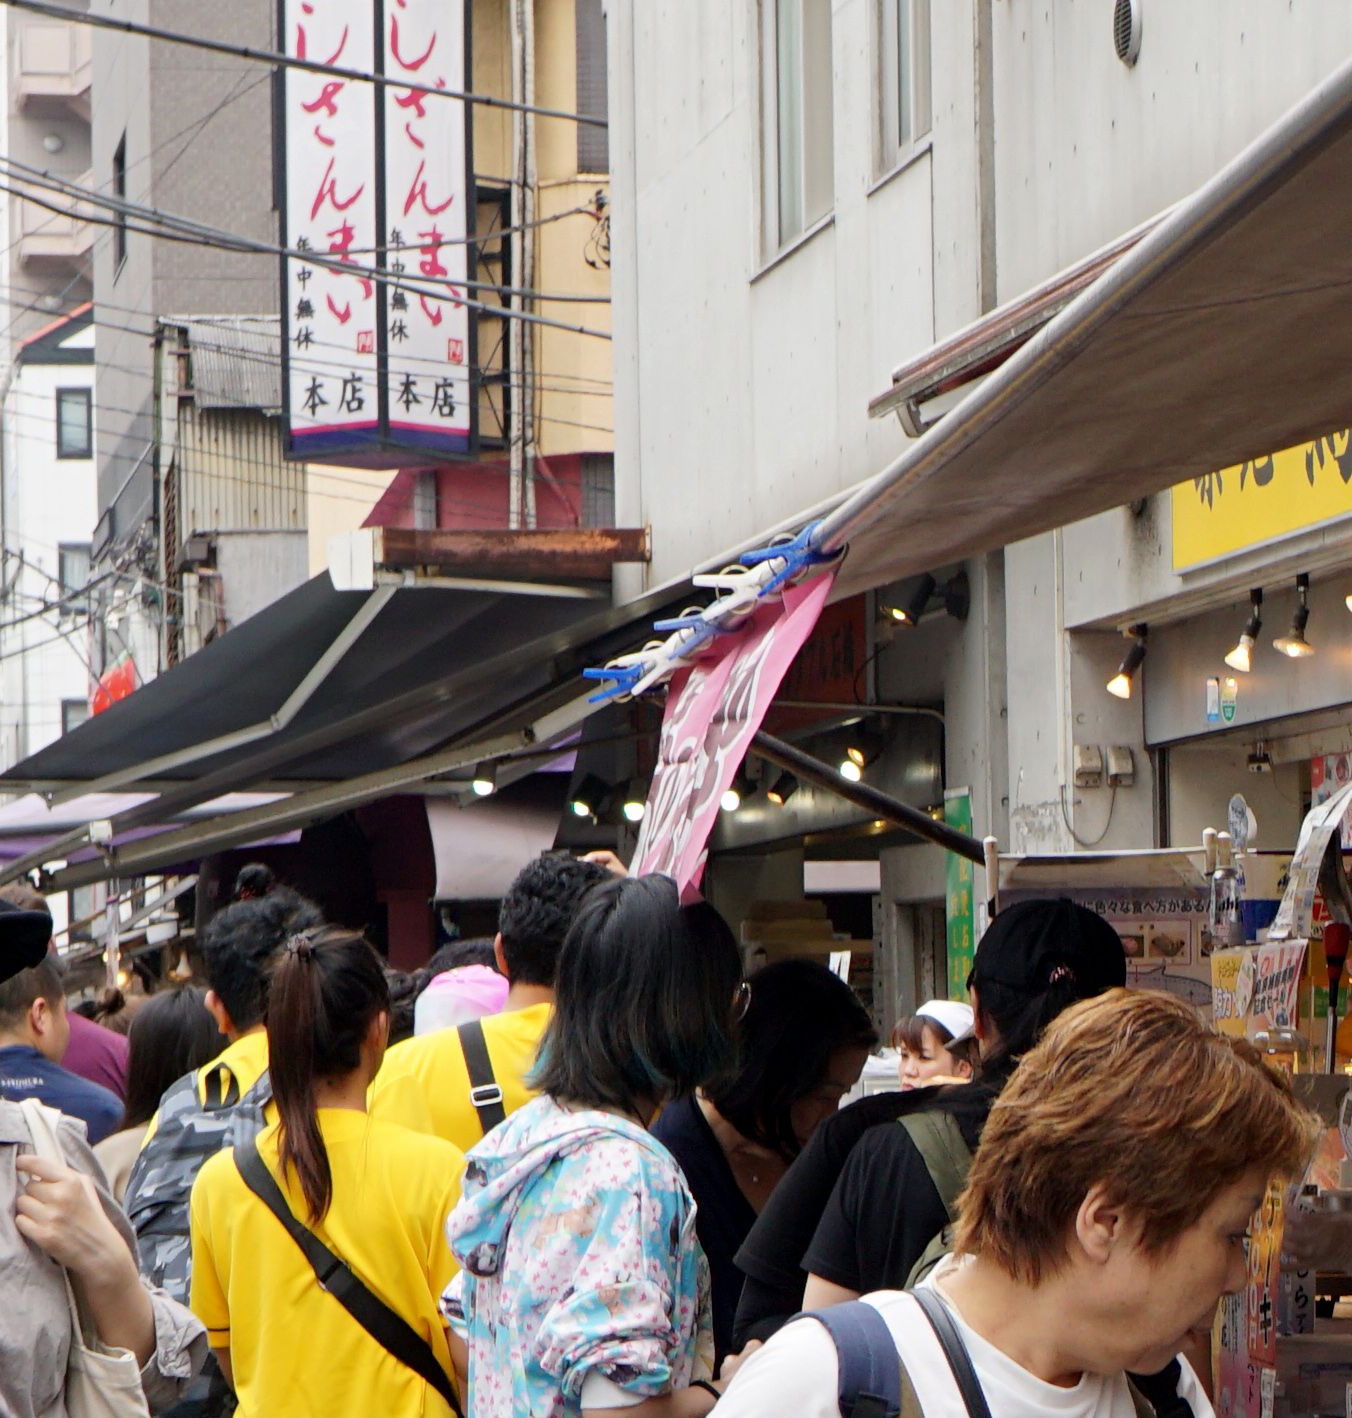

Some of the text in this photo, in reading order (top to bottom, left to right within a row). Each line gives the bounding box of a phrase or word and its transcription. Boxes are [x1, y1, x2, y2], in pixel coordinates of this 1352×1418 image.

[297, 0, 373, 324] しざんまい
[391, 0, 463, 327] しざんまい
[302, 371, 365, 417] 本店
[397, 373, 456, 419] 本店
